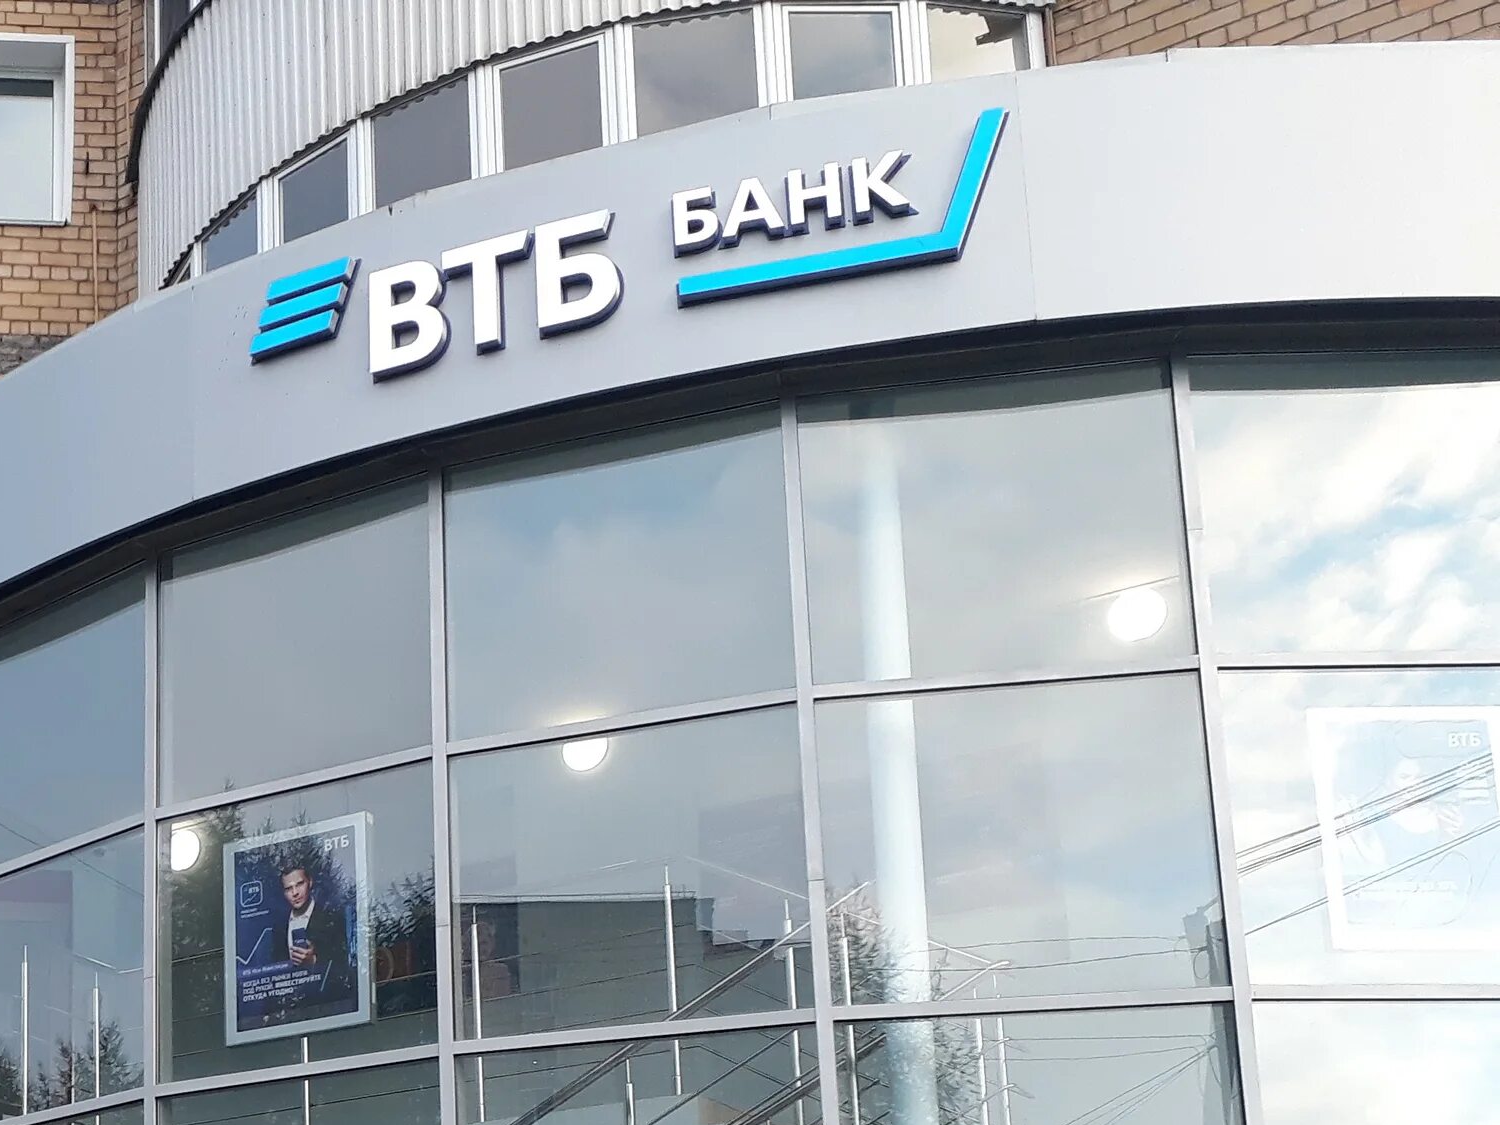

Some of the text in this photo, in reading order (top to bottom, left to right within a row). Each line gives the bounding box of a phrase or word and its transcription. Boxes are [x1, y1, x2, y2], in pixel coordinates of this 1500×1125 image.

[367, 148, 919, 382] ВТБ БАНК
[1448, 732, 1482, 748] ВТБ
[324, 834, 350, 852] ВТБ
